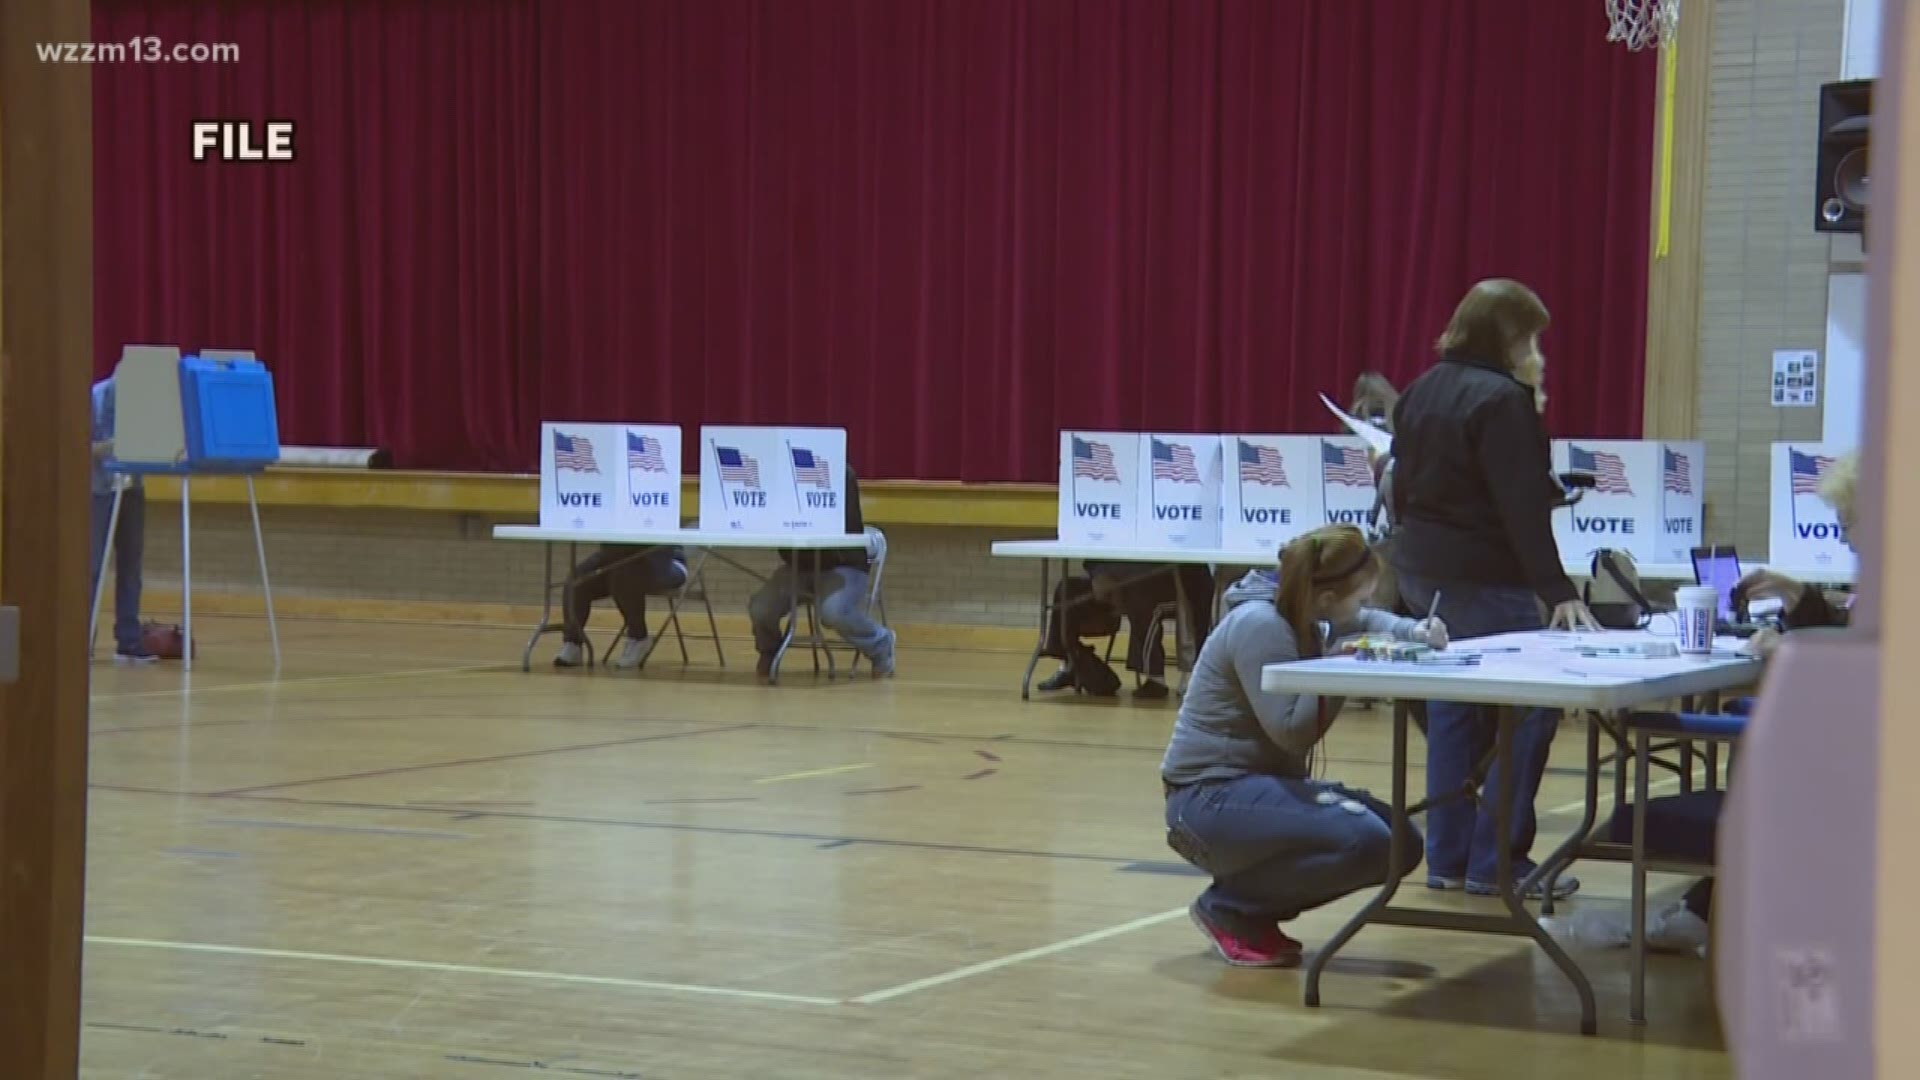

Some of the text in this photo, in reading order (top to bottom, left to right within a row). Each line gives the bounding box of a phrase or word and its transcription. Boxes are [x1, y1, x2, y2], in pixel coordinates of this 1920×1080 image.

[560, 491, 602, 508] VOTE
[632, 491, 670, 507] VOTE
[733, 490, 767, 508] VOTE
[806, 491, 837, 508] VOTE
[1077, 502, 1122, 519] VOTE
[1156, 504, 1202, 520] VOTE
[1243, 508, 1291, 524] VOTE
[1576, 516, 1635, 534] VOTE
[1665, 516, 1693, 534] VOTE
[1797, 523, 1839, 539] VOT
